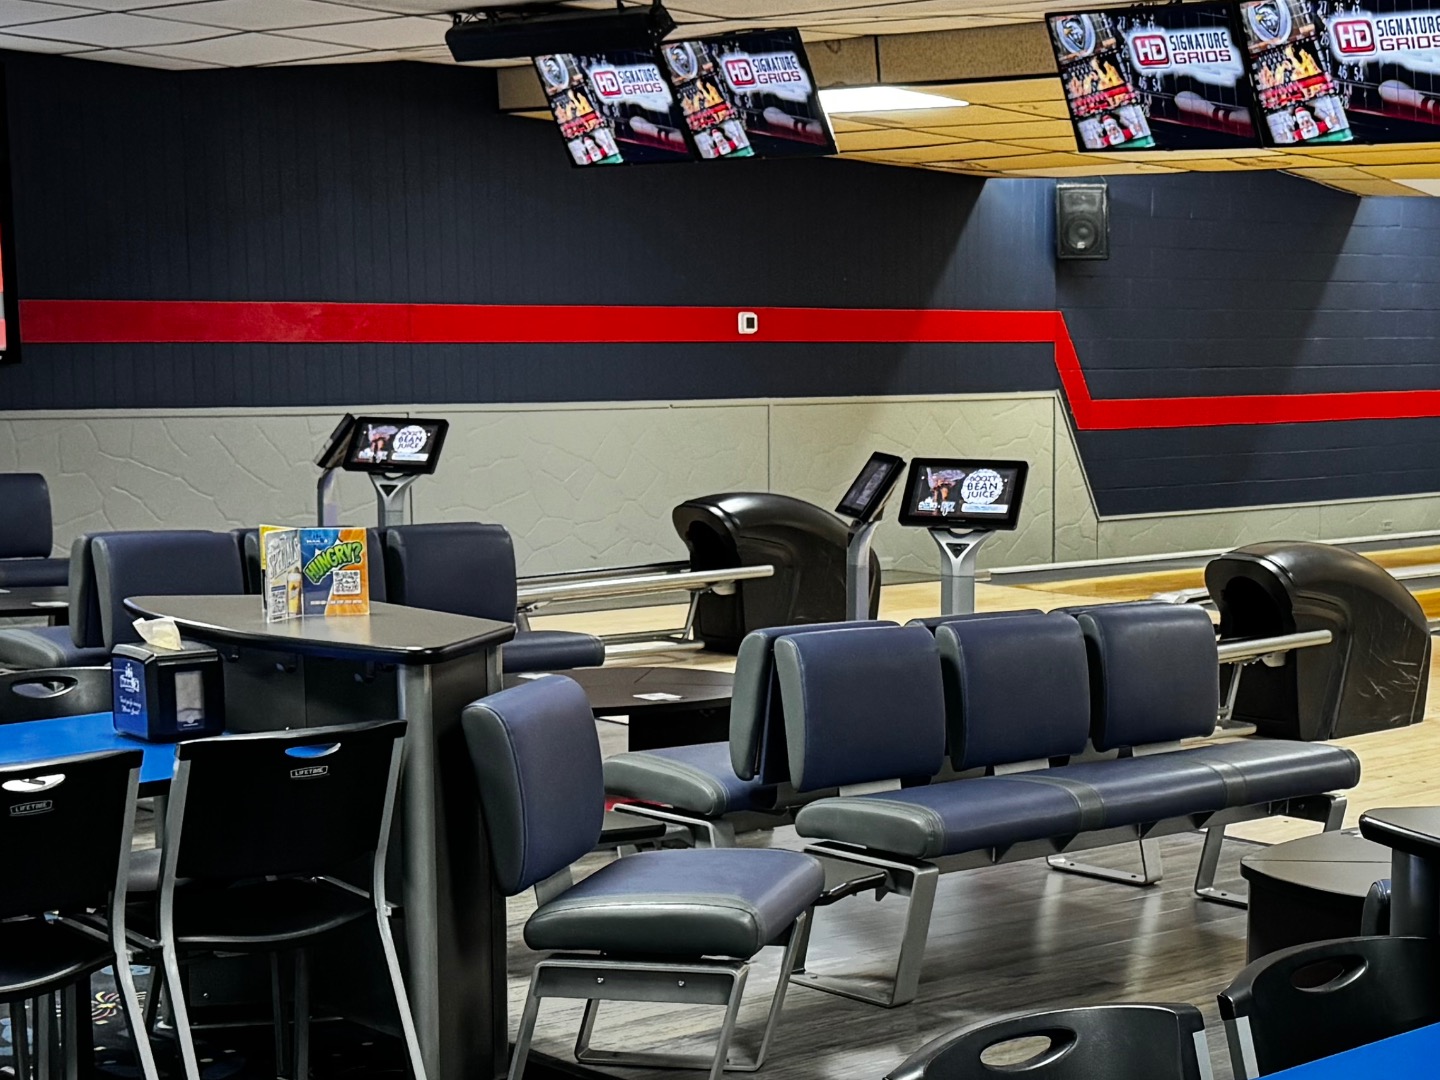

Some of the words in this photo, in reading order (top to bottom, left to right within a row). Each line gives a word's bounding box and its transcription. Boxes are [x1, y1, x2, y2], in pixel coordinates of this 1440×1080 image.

[1169, 32, 1229, 52] SIGNATURE
[1336, 22, 1374, 49] HD
[1134, 36, 1168, 62] HD
[1173, 50, 1232, 65] GRIDS
[726, 61, 755, 82] HD
[752, 55, 798, 73] SIGNATURE
[595, 72, 619, 93] HD
[617, 67, 659, 85] SIGNATURE
[757, 71, 802, 85] GRIDS
[622, 82, 663, 95] GRIDS
[967, 482, 998, 491] BEAN
[967, 490, 995, 499] JUICE
[304, 541, 363, 584] HUNGRY?
